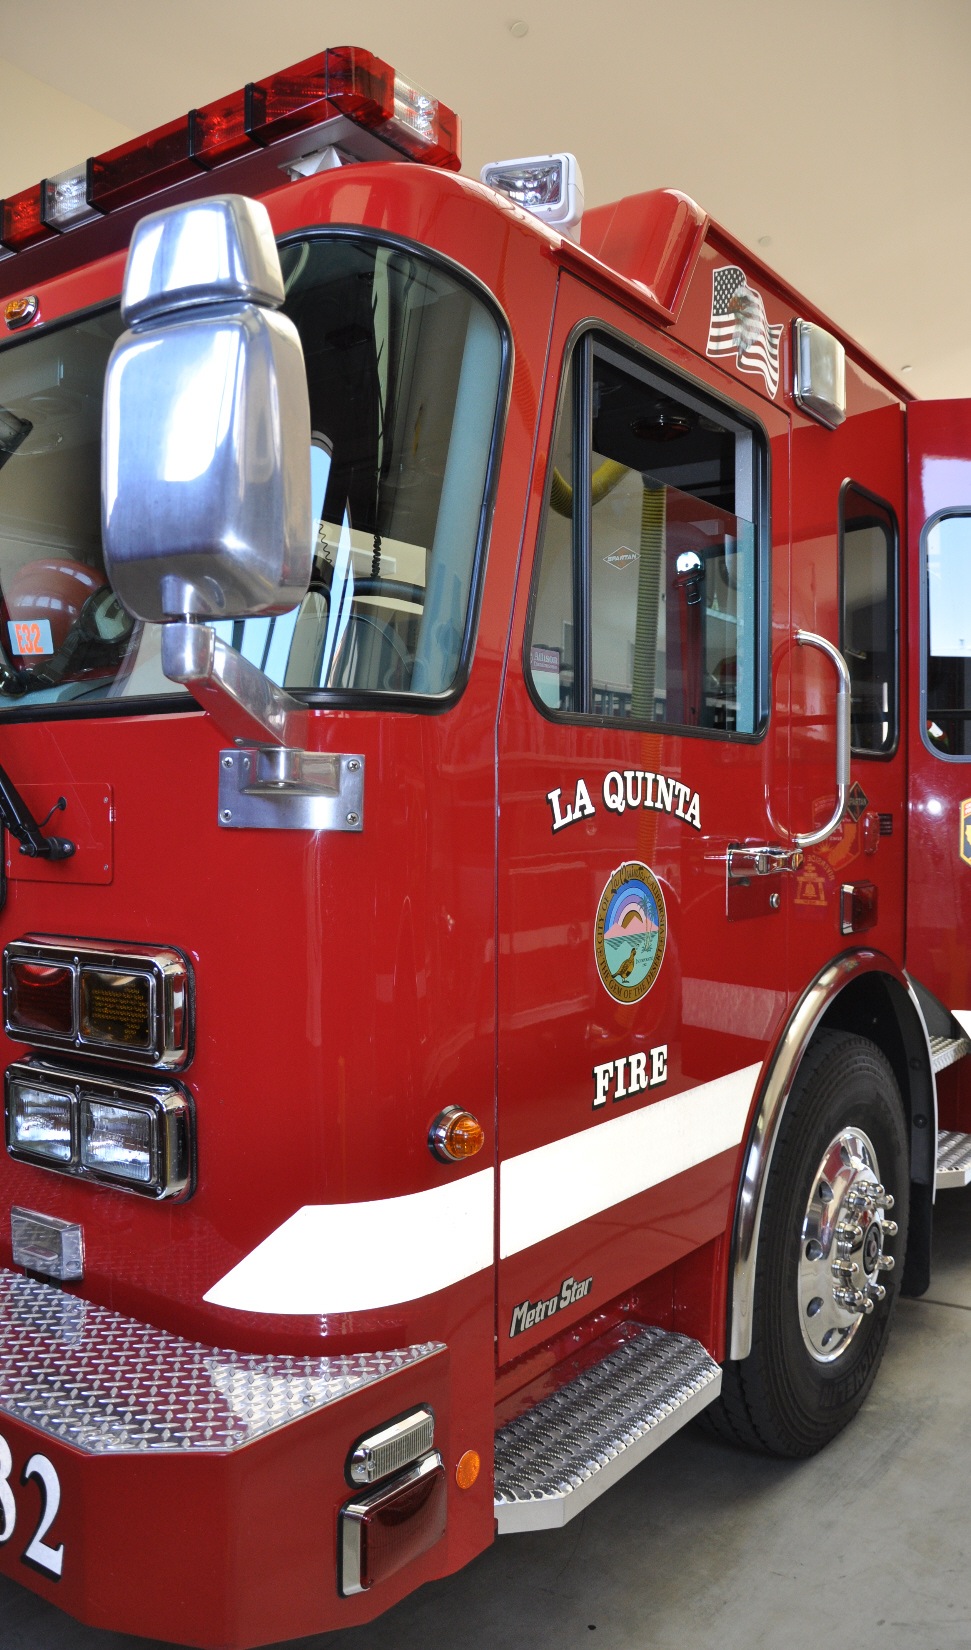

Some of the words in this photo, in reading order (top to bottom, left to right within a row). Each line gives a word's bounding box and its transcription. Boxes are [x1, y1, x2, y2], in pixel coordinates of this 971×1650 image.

[607, 554, 637, 562] SPARTAN
[14, 623, 44, 654] E32
[533, 651, 558, 665] Allison
[547, 778, 596, 835] LA
[602, 769, 702, 832] QUINTA
[623, 989, 632, 999] OF
[592, 1044, 668, 1111] FIRE
[509, 1299, 558, 1338] Metro
[560, 1276, 593, 1310] Star
